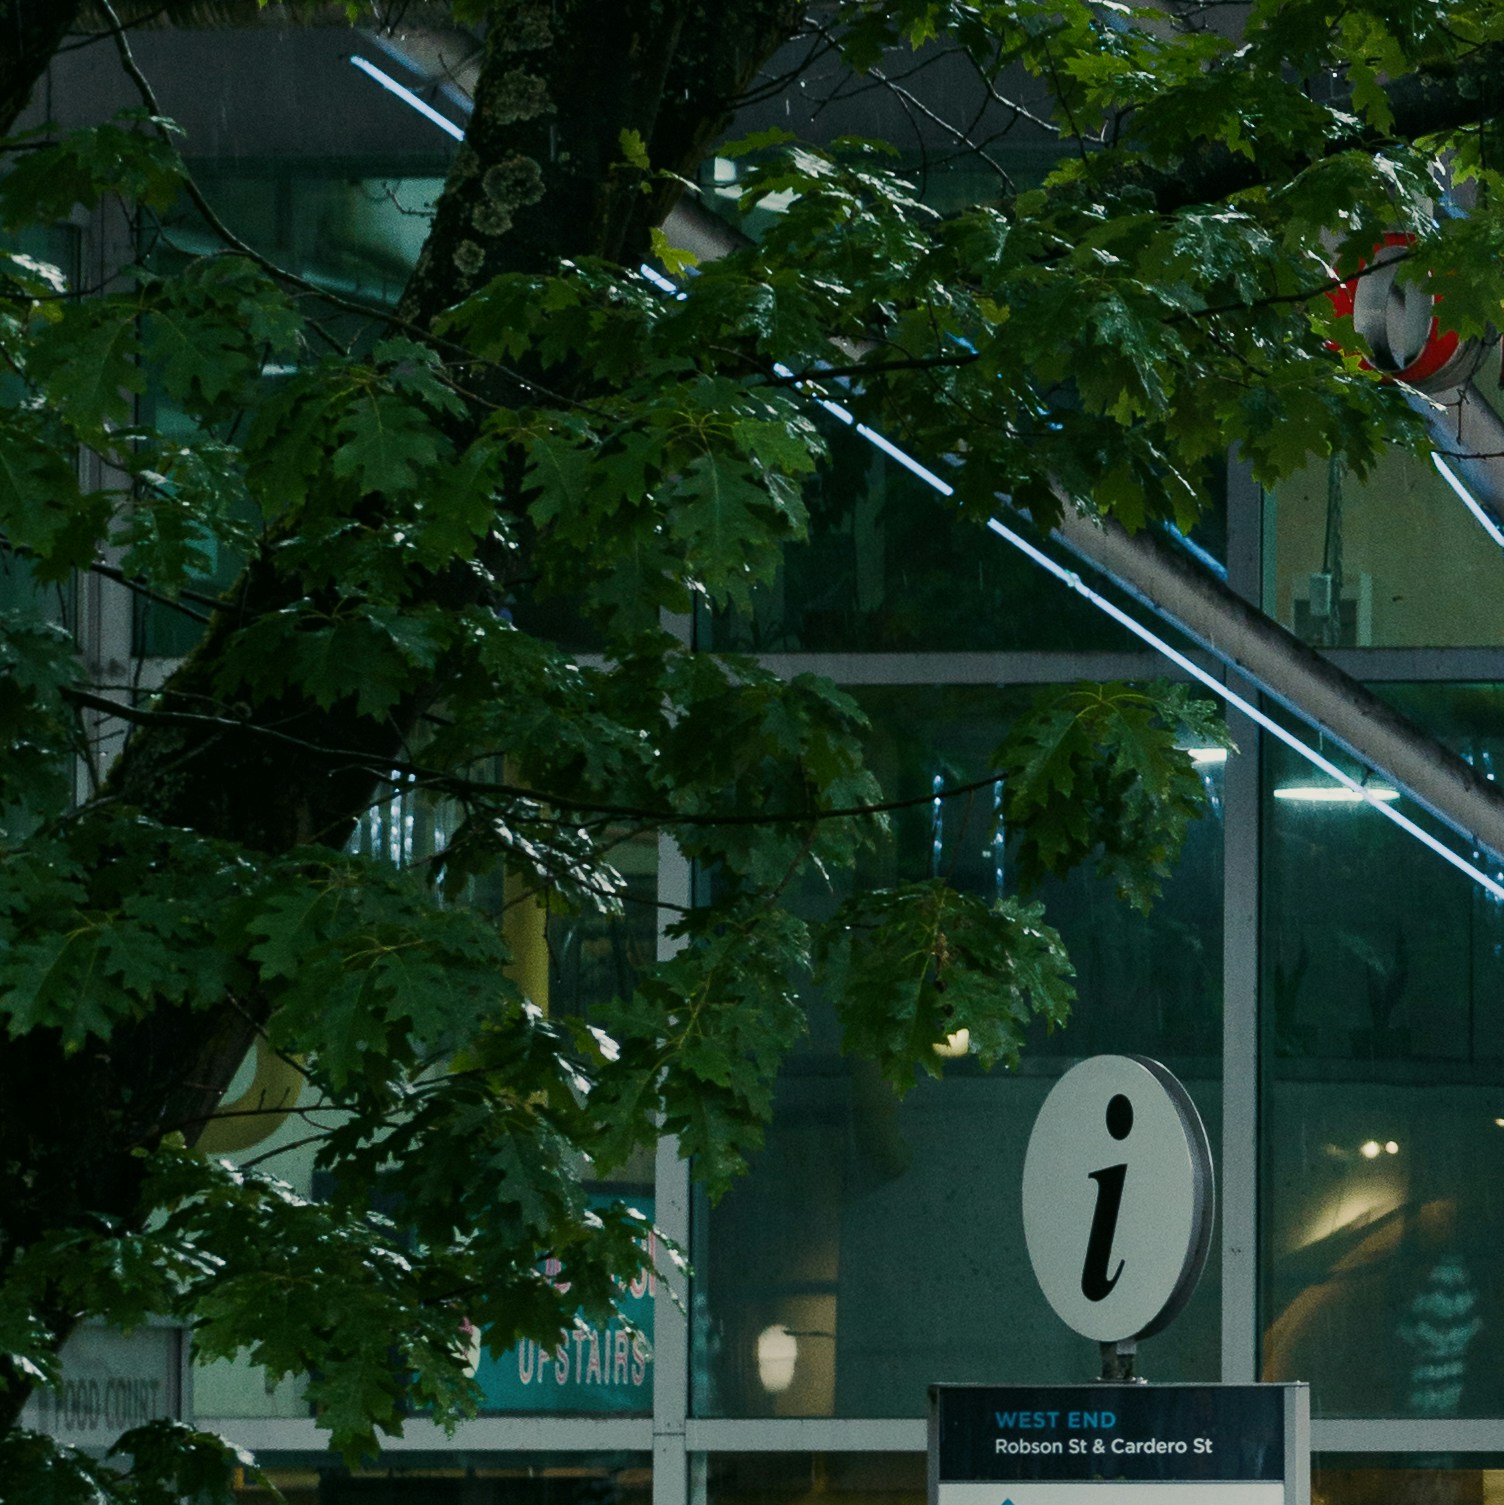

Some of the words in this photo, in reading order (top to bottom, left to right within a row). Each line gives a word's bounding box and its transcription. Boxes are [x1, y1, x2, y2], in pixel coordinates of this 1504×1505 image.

[995, 1411, 1060, 1429] WEST
[1067, 1411, 1116, 1429] END
[995, 1437, 1062, 1455] Robson
[1069, 1437, 1088, 1455] St
[1092, 1437, 1106, 1455] &
[1110, 1437, 1188, 1455] Cardero
[1193, 1437, 1213, 1455] St
